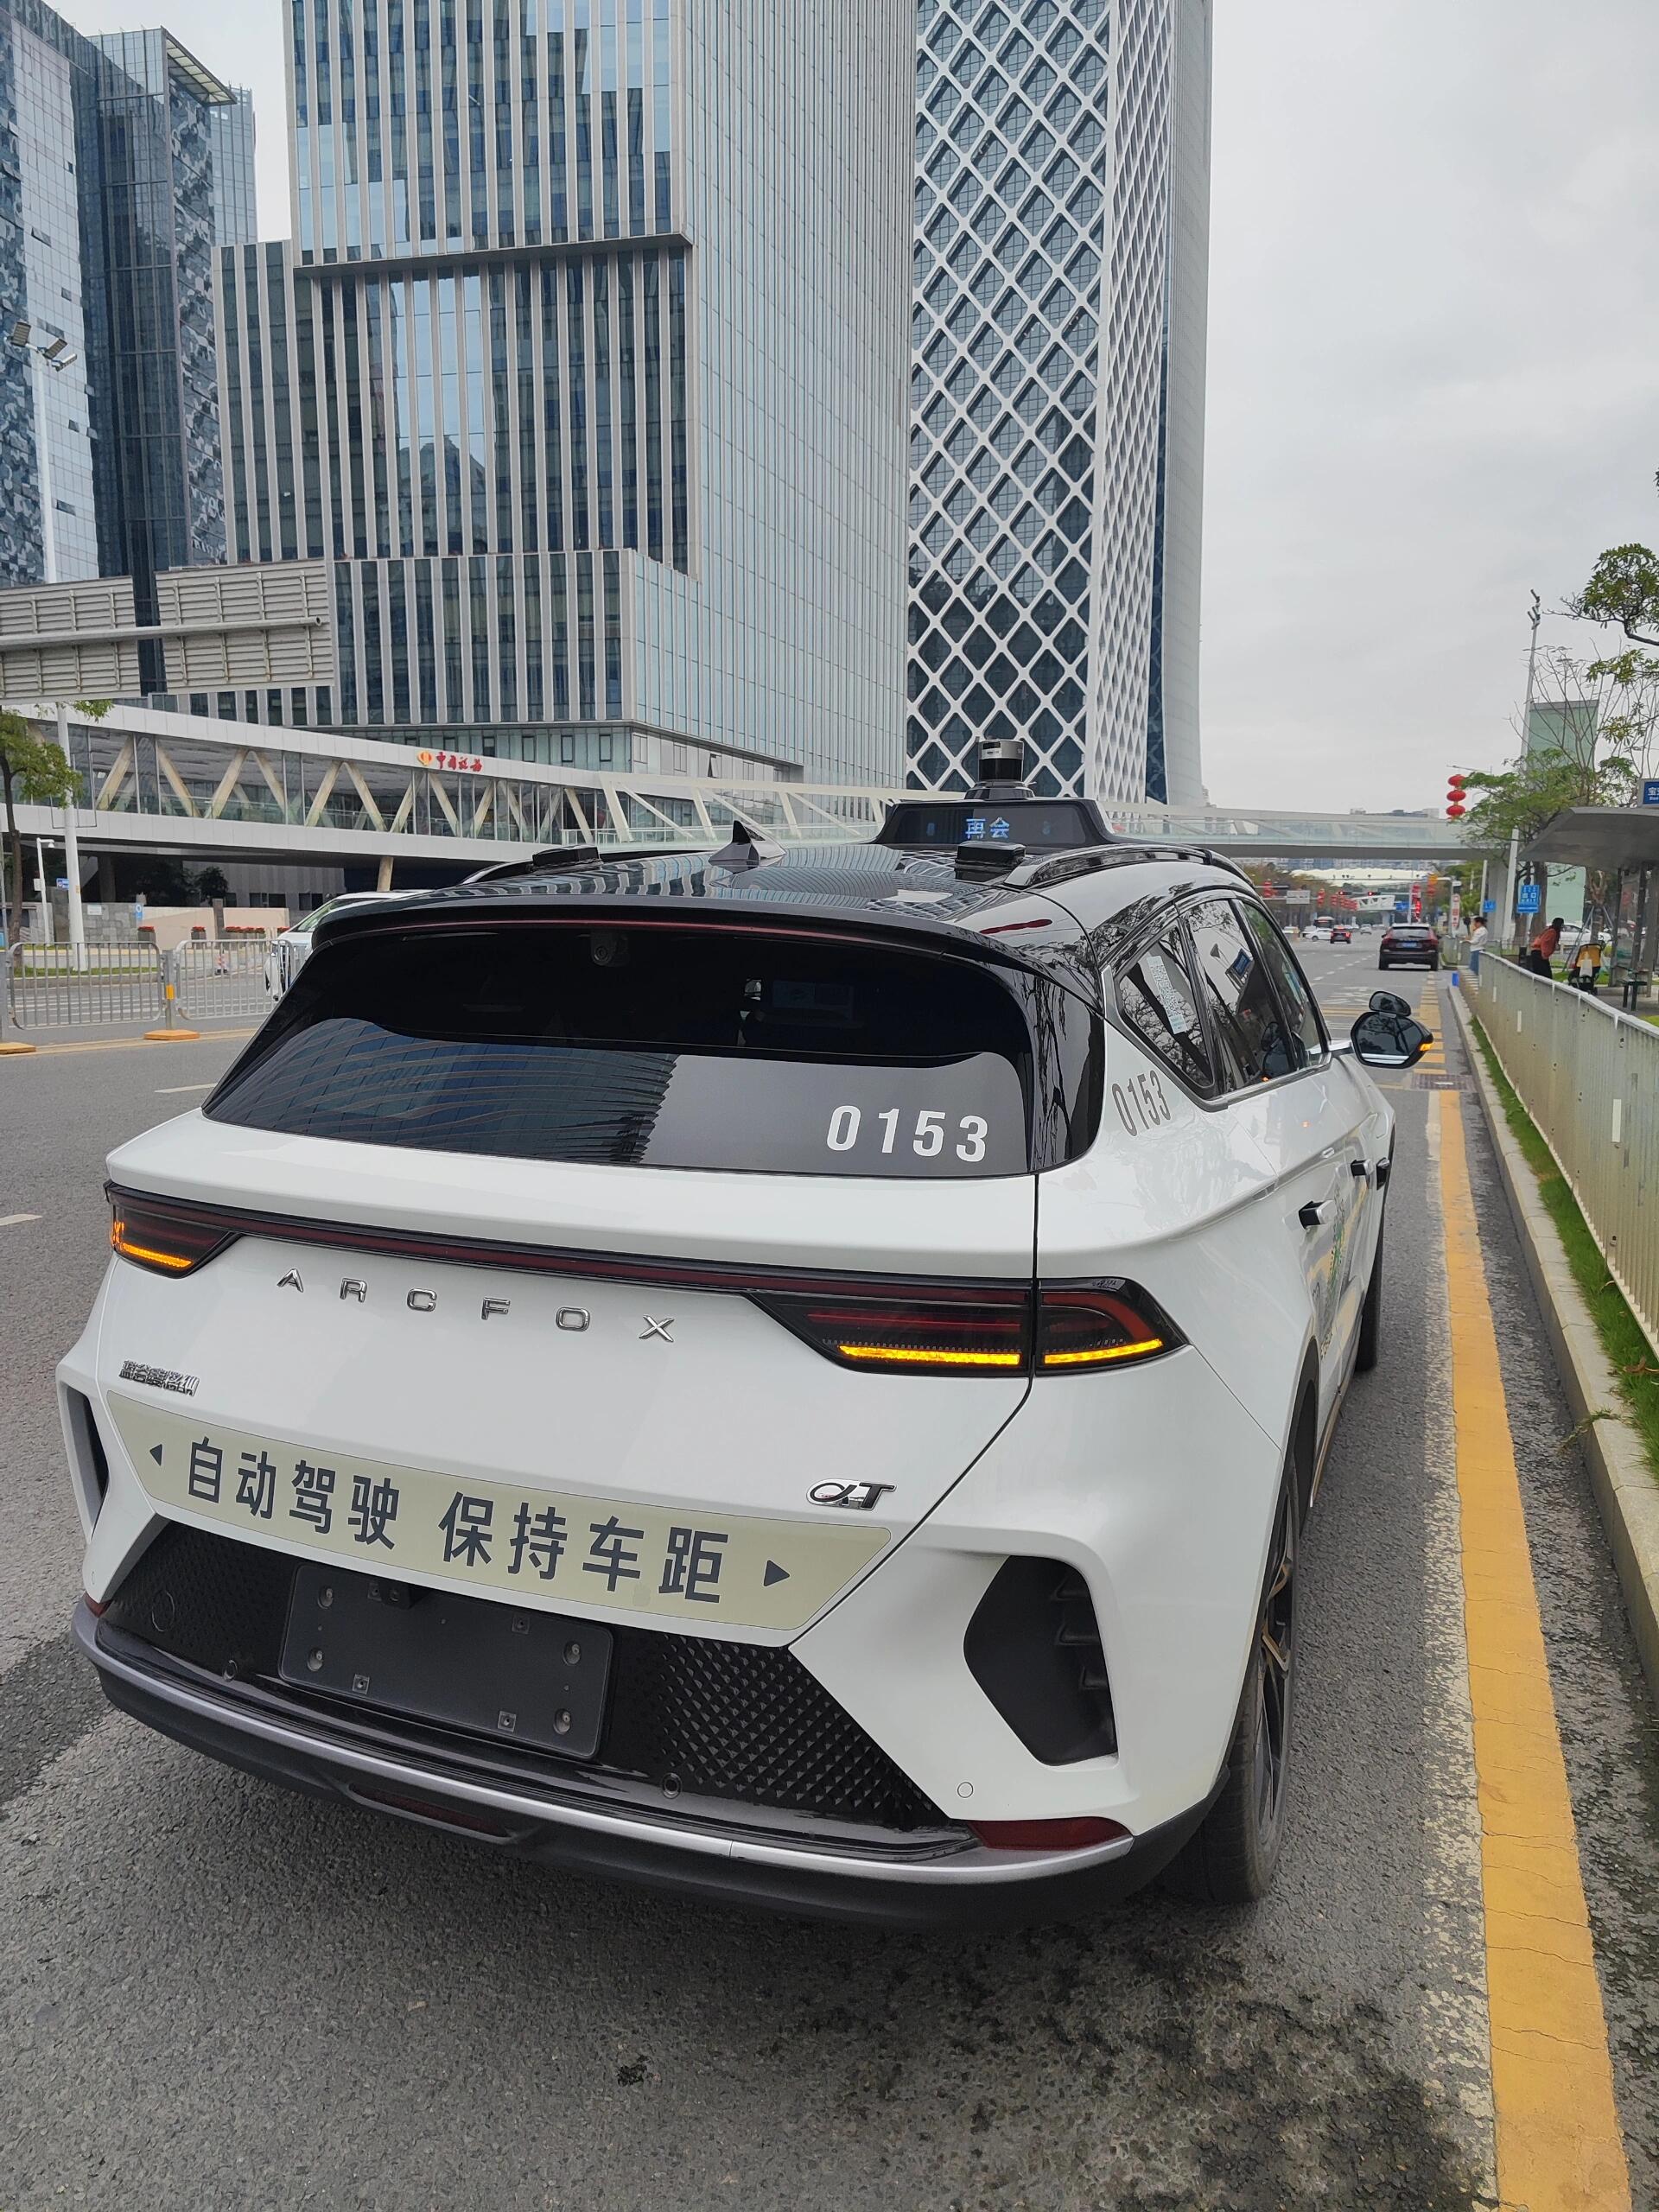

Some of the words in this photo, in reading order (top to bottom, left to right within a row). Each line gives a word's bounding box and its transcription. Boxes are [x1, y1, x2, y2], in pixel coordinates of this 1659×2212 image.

[965, 817, 1010, 839] 再会
[826, 1104, 988, 1162] 0153
[1111, 1070, 1171, 1136] 0153
[276, 1268, 675, 1343] ARCFOX
[188, 1436, 400, 1550] 自动驾驶
[438, 1491, 729, 1604] 保持车距
